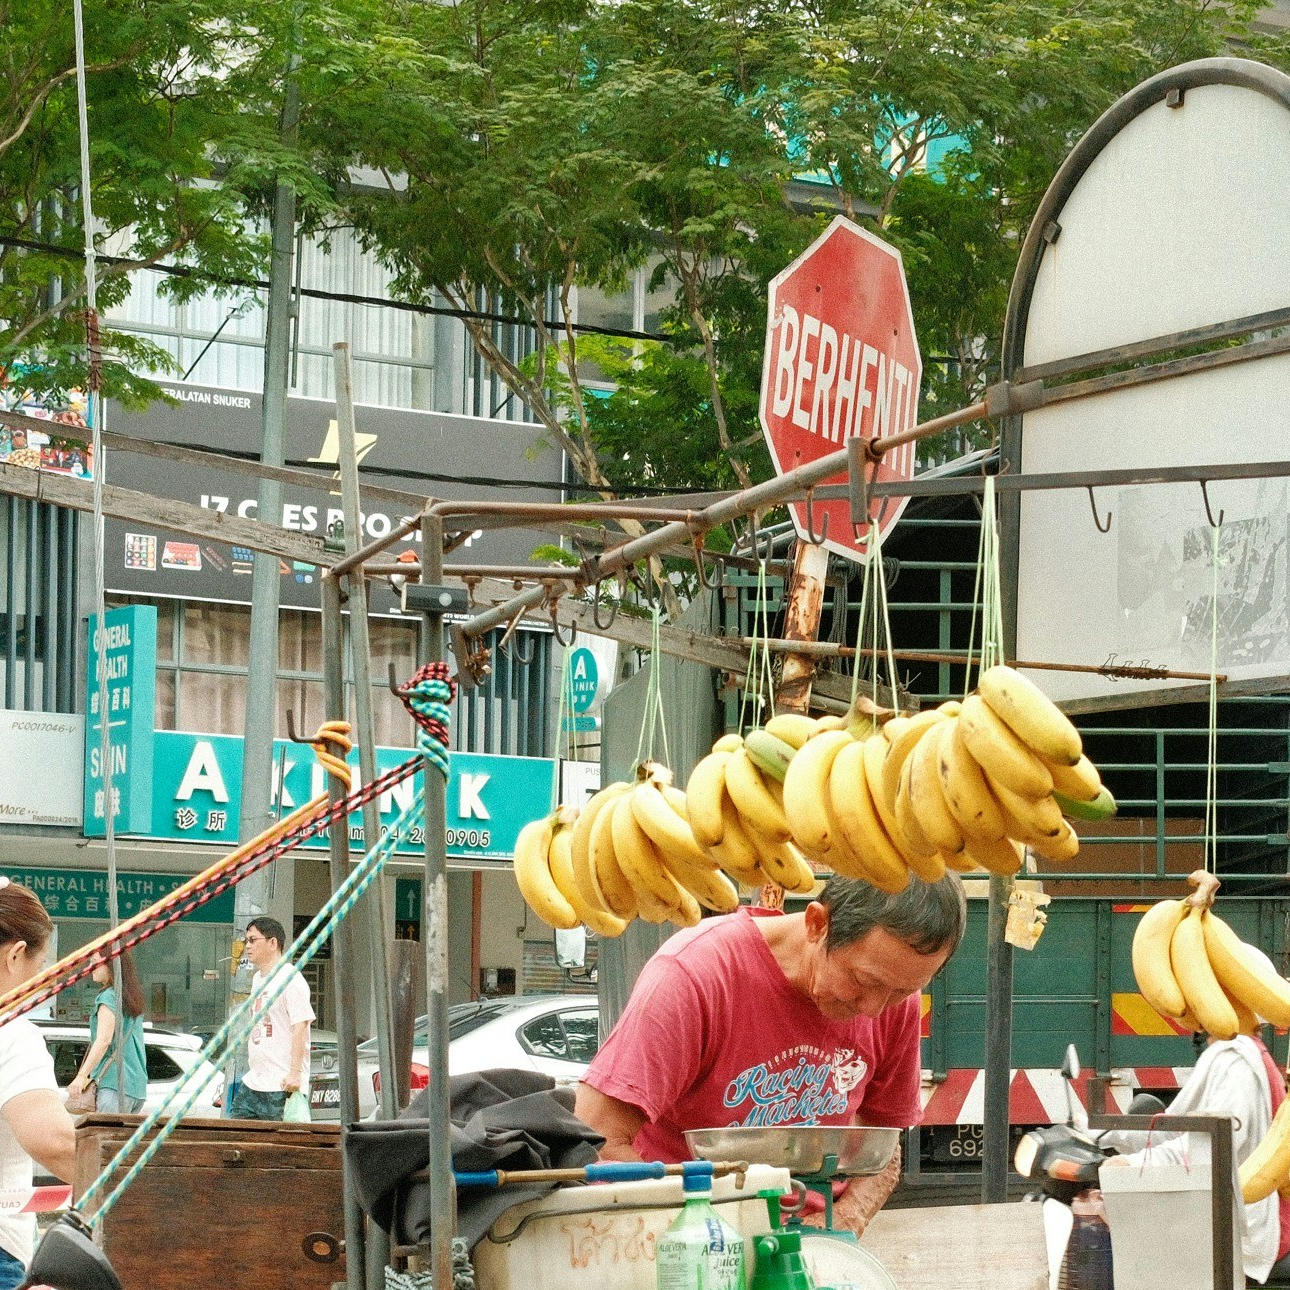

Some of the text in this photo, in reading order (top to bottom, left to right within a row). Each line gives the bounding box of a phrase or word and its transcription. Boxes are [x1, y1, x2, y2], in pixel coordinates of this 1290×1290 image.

[162, 387, 251, 409] ERALATAN SNUKER
[772, 304, 914, 477] BERHENTI
[237, 499, 317, 532] CES
[573, 655, 587, 680] A
[91, 744, 127, 778] SIN
[174, 741, 229, 803] A
[175, 809, 228, 831] 诊所
[10, 874, 87, 891] GENERAL
[723, 1058, 832, 1108] Racing
